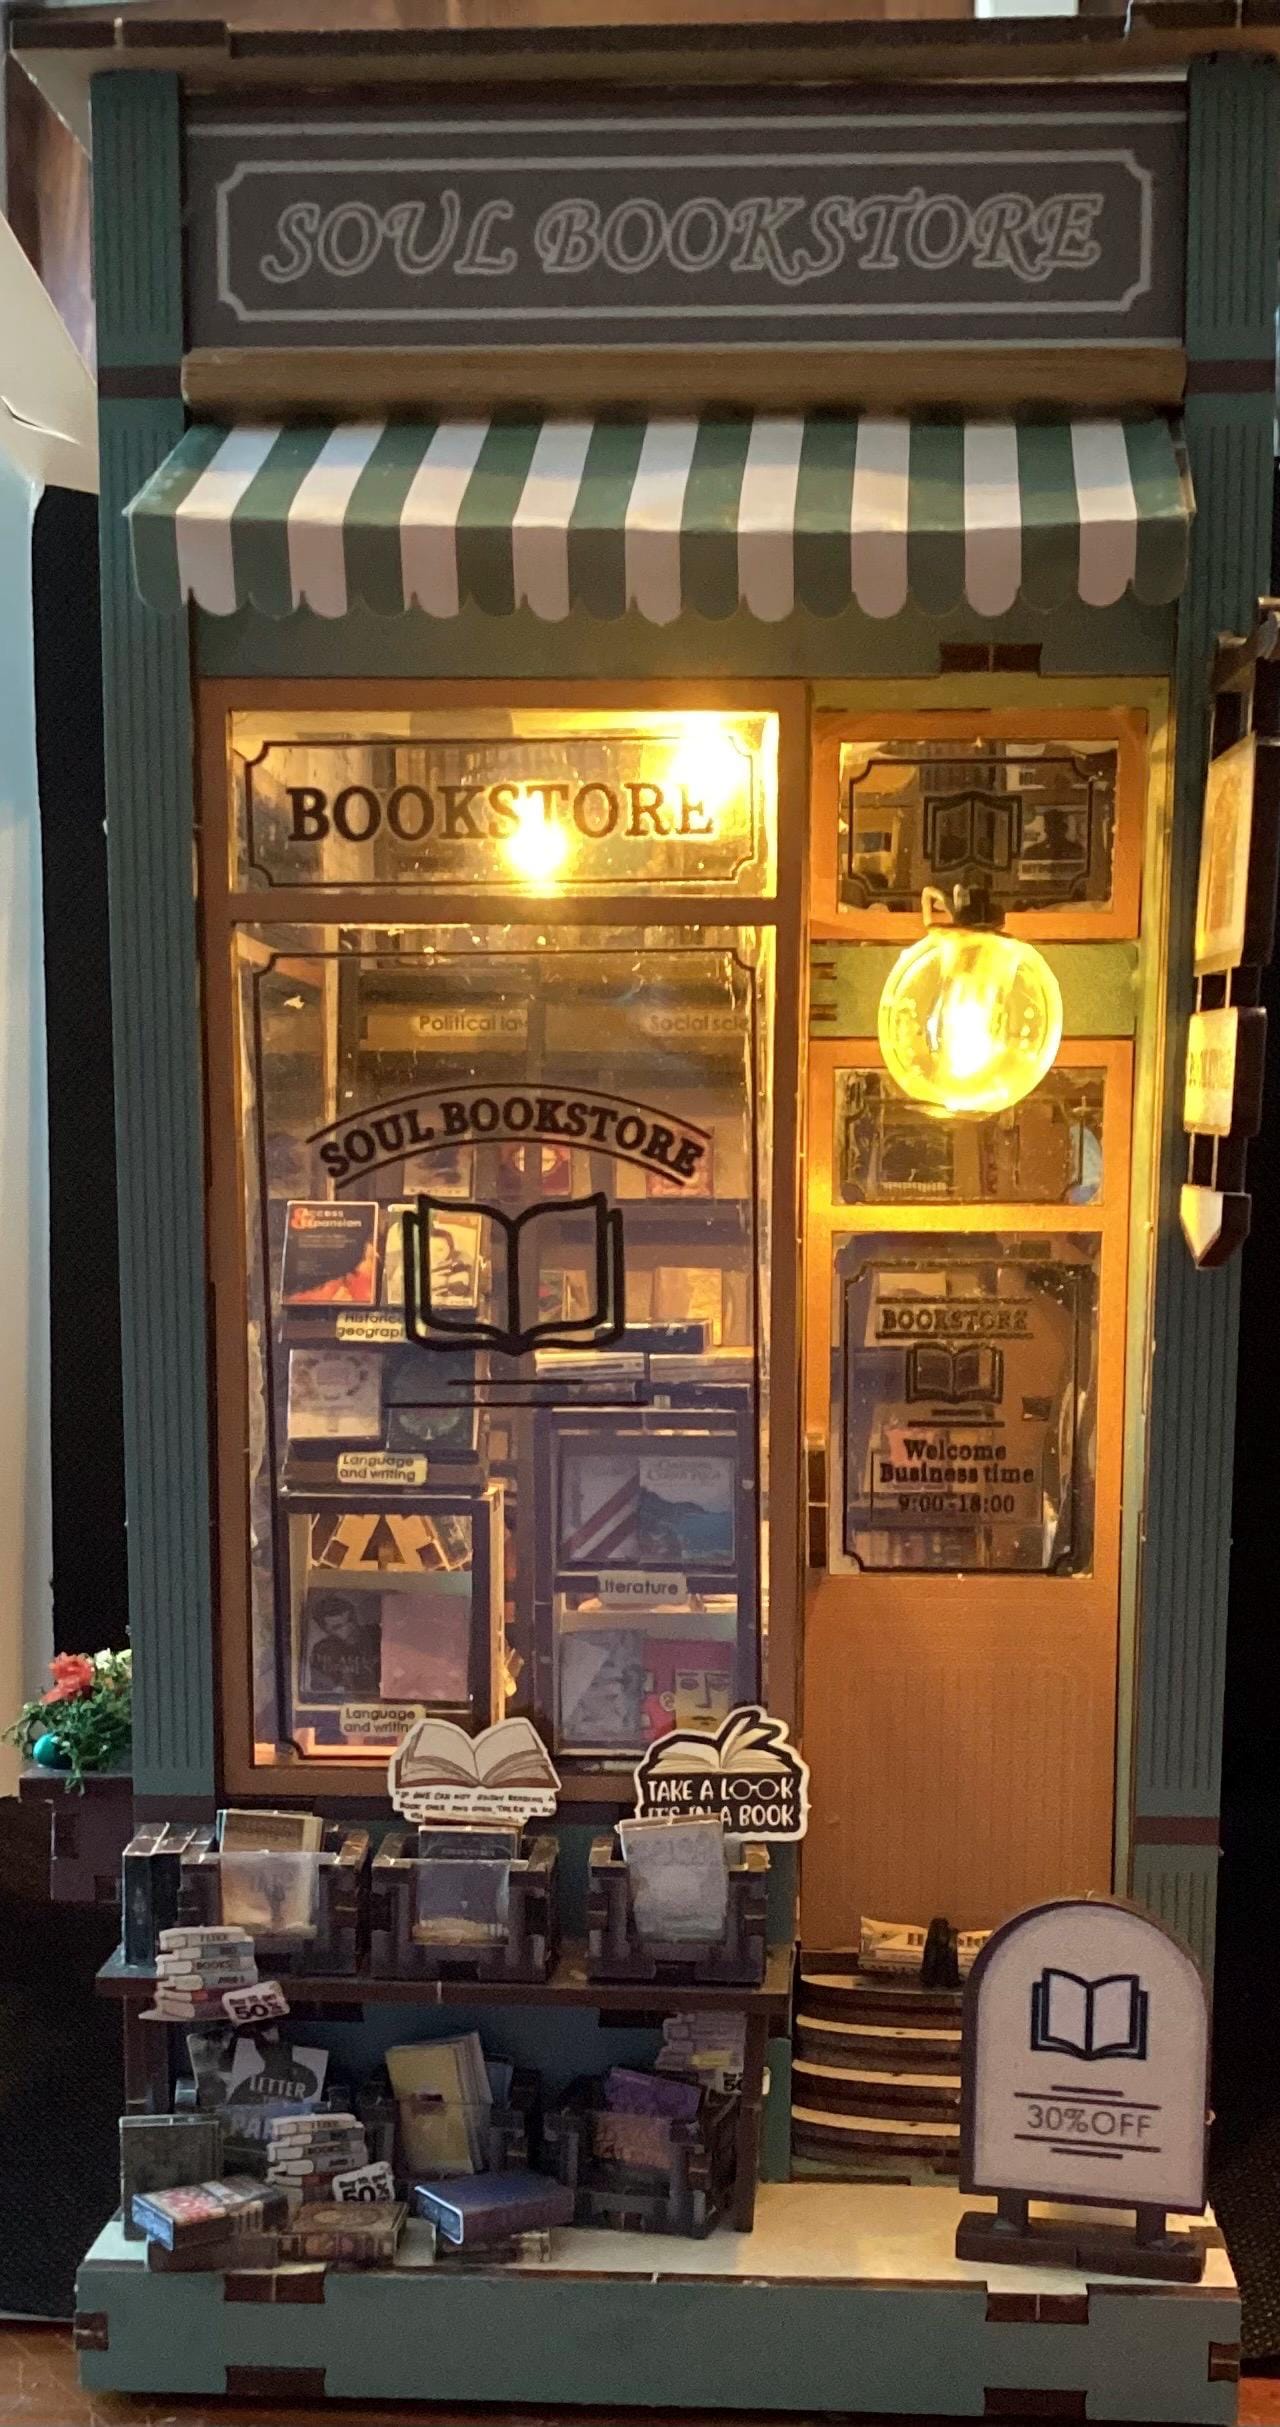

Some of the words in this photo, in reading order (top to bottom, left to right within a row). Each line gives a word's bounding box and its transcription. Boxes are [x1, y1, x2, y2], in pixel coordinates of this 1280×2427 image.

[260, 190, 517, 284] SOUL
[534, 187, 1105, 286] BOOKSTORE
[287, 782, 715, 842] BOOKSTORE
[419, 1014, 497, 1032] Political
[319, 1111, 435, 1180] SOUL
[442, 1098, 705, 1179] BOOKSTORE
[881, 1308, 1029, 1331] BOOKSTORE
[342, 1454, 415, 1468] Language
[903, 1439, 1007, 1461] Welcome
[339, 1468, 367, 1480] and
[369, 1468, 417, 1483] writing
[880, 1462, 978, 1484] Business
[983, 1463, 1035, 1484] time
[345, 1707, 416, 1721] Language
[343, 1721, 371, 1733] and
[373, 1721, 411, 1734] writin
[647, 1779, 693, 1802] TAKE
[700, 1779, 714, 1801] A
[721, 1777, 794, 1801] LOOK
[720, 1805, 733, 1827] A
[739, 1803, 794, 1827] BOOK
[1027, 2103, 1153, 2139] 30%OFF
